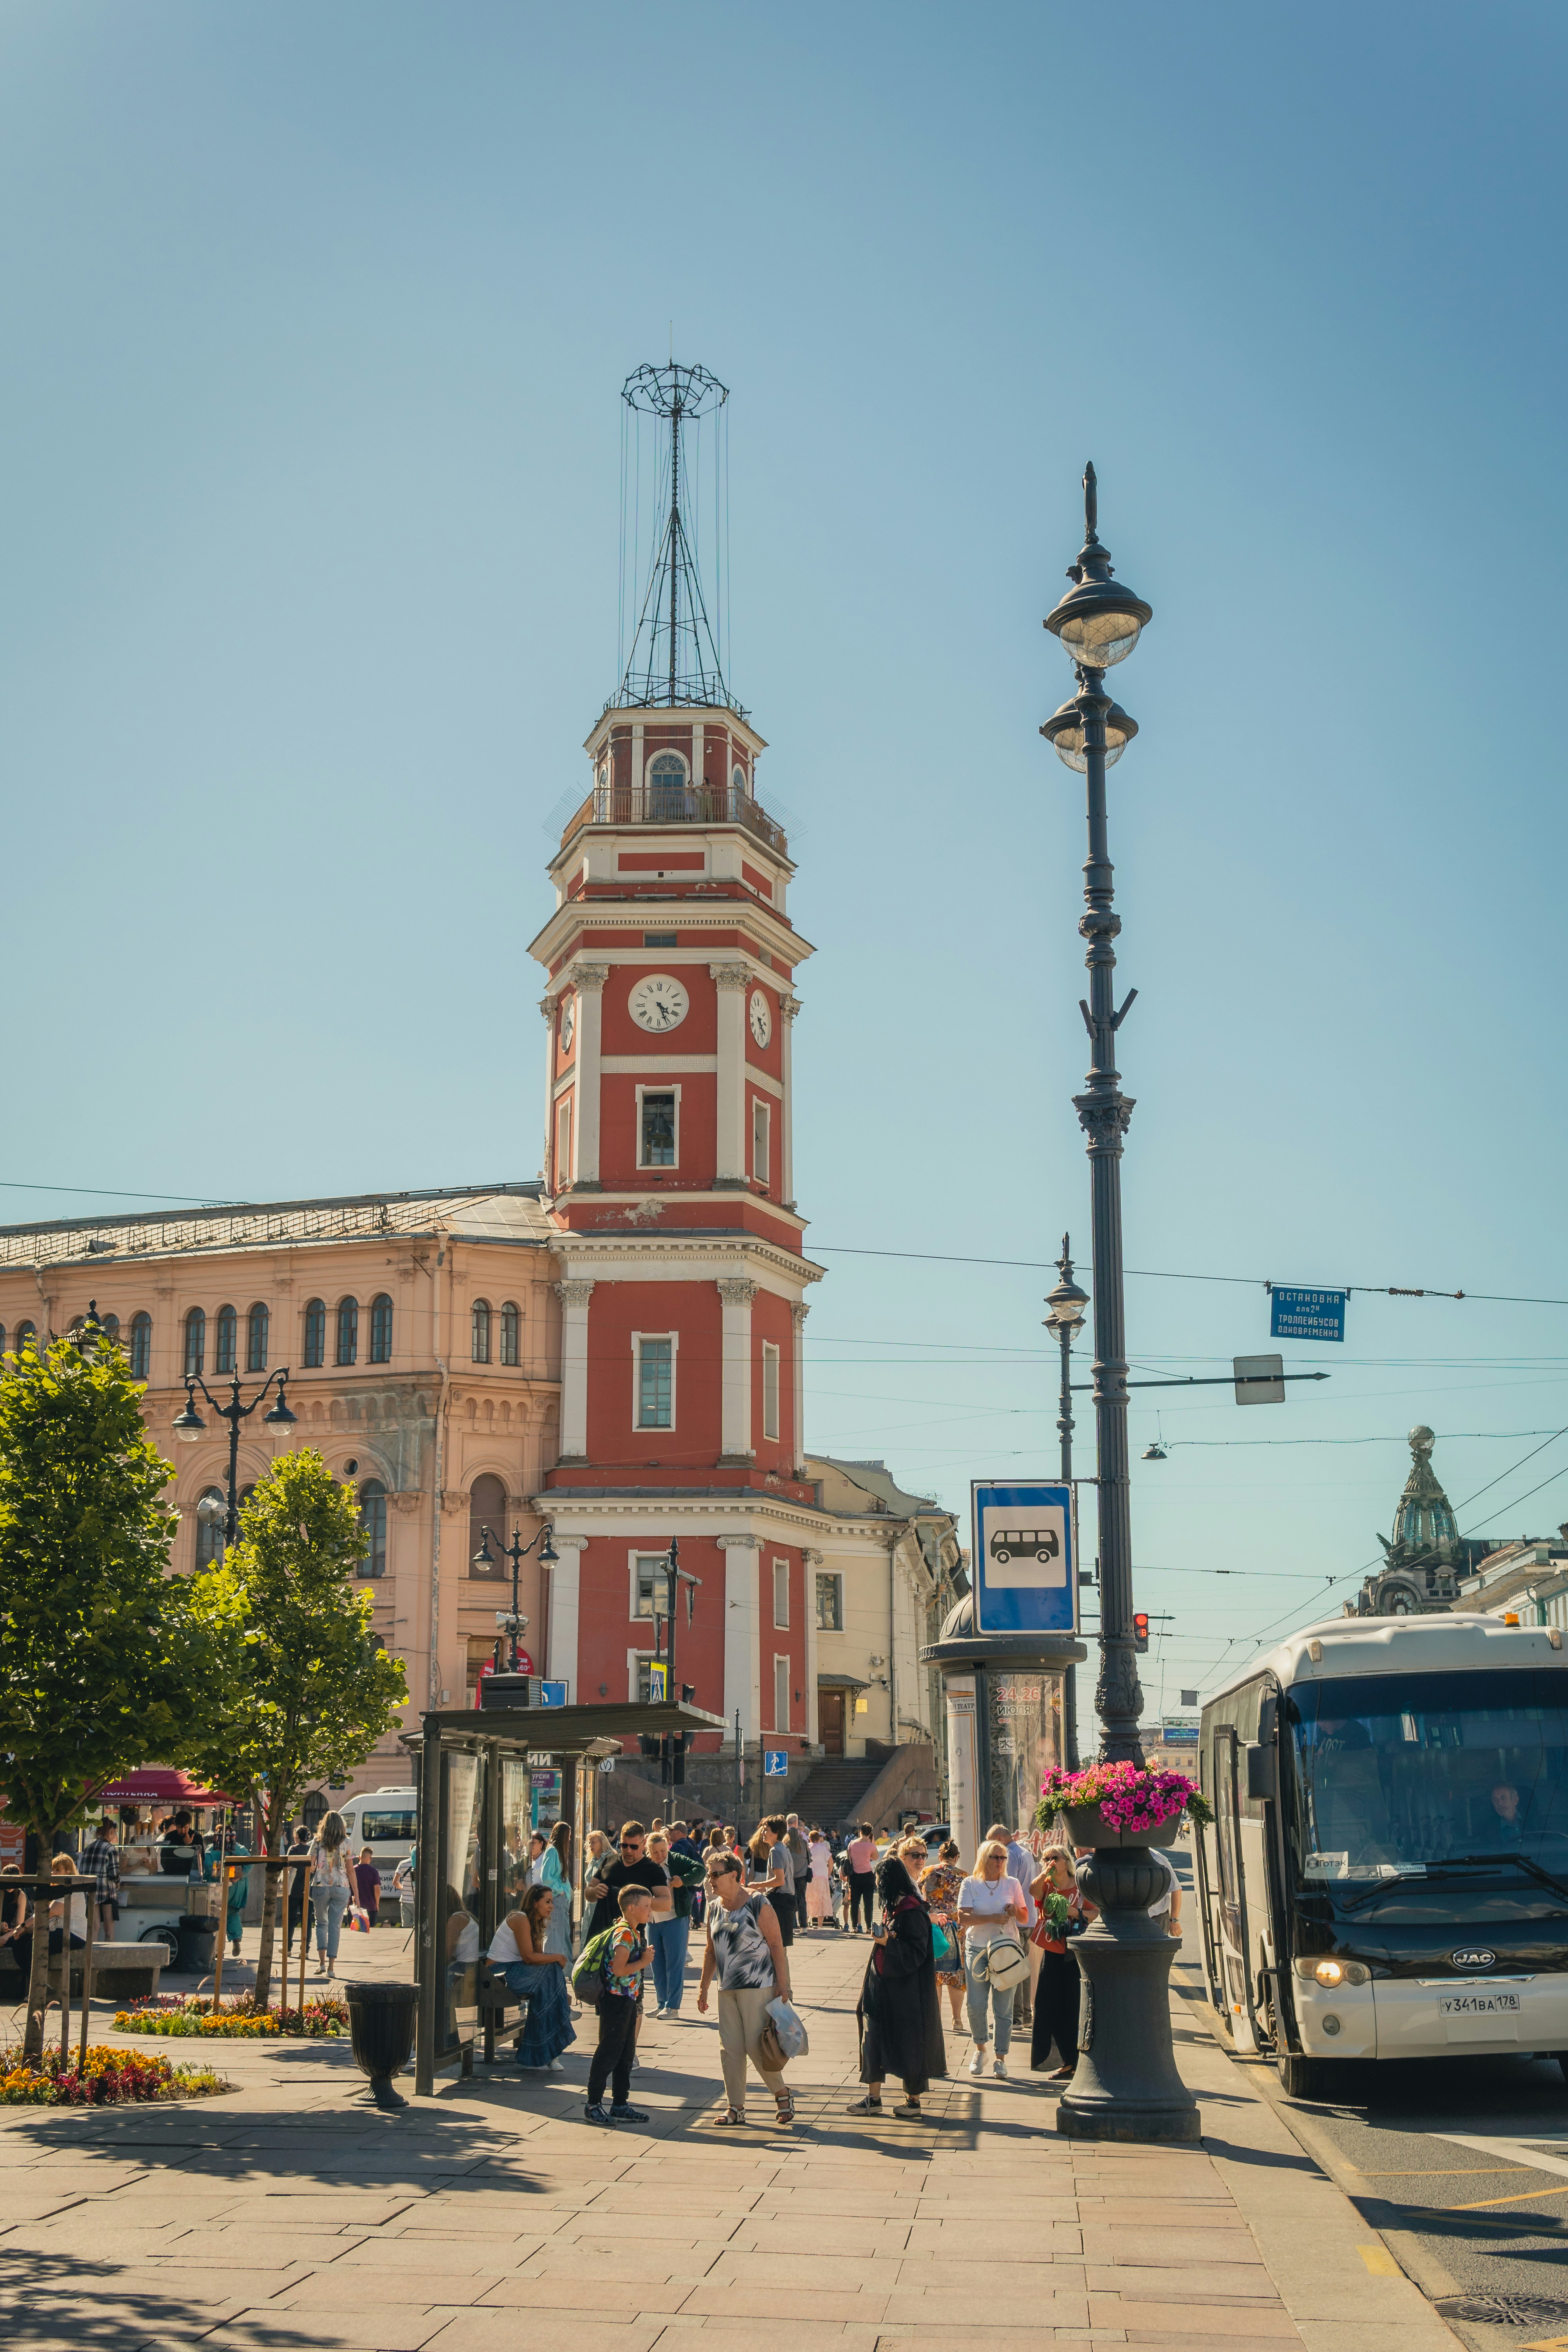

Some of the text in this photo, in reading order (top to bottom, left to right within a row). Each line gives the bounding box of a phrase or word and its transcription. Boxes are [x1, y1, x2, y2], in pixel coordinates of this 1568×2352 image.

[1279, 1292, 1339, 1304] ОСТАНОВКА
[1279, 1314, 1338, 1327] ТРОЛЛЕЙБУСОВ
[1278, 1326, 1338, 1338] ОДНОВРЕМЕННО
[996, 1687, 1040, 1703] 24,26
[997, 1705, 1031, 1716] ИЮЛЯ
[1457, 1954, 1491, 1963] JAC
[1445, 1996, 1515, 2012] У341ВА 178
